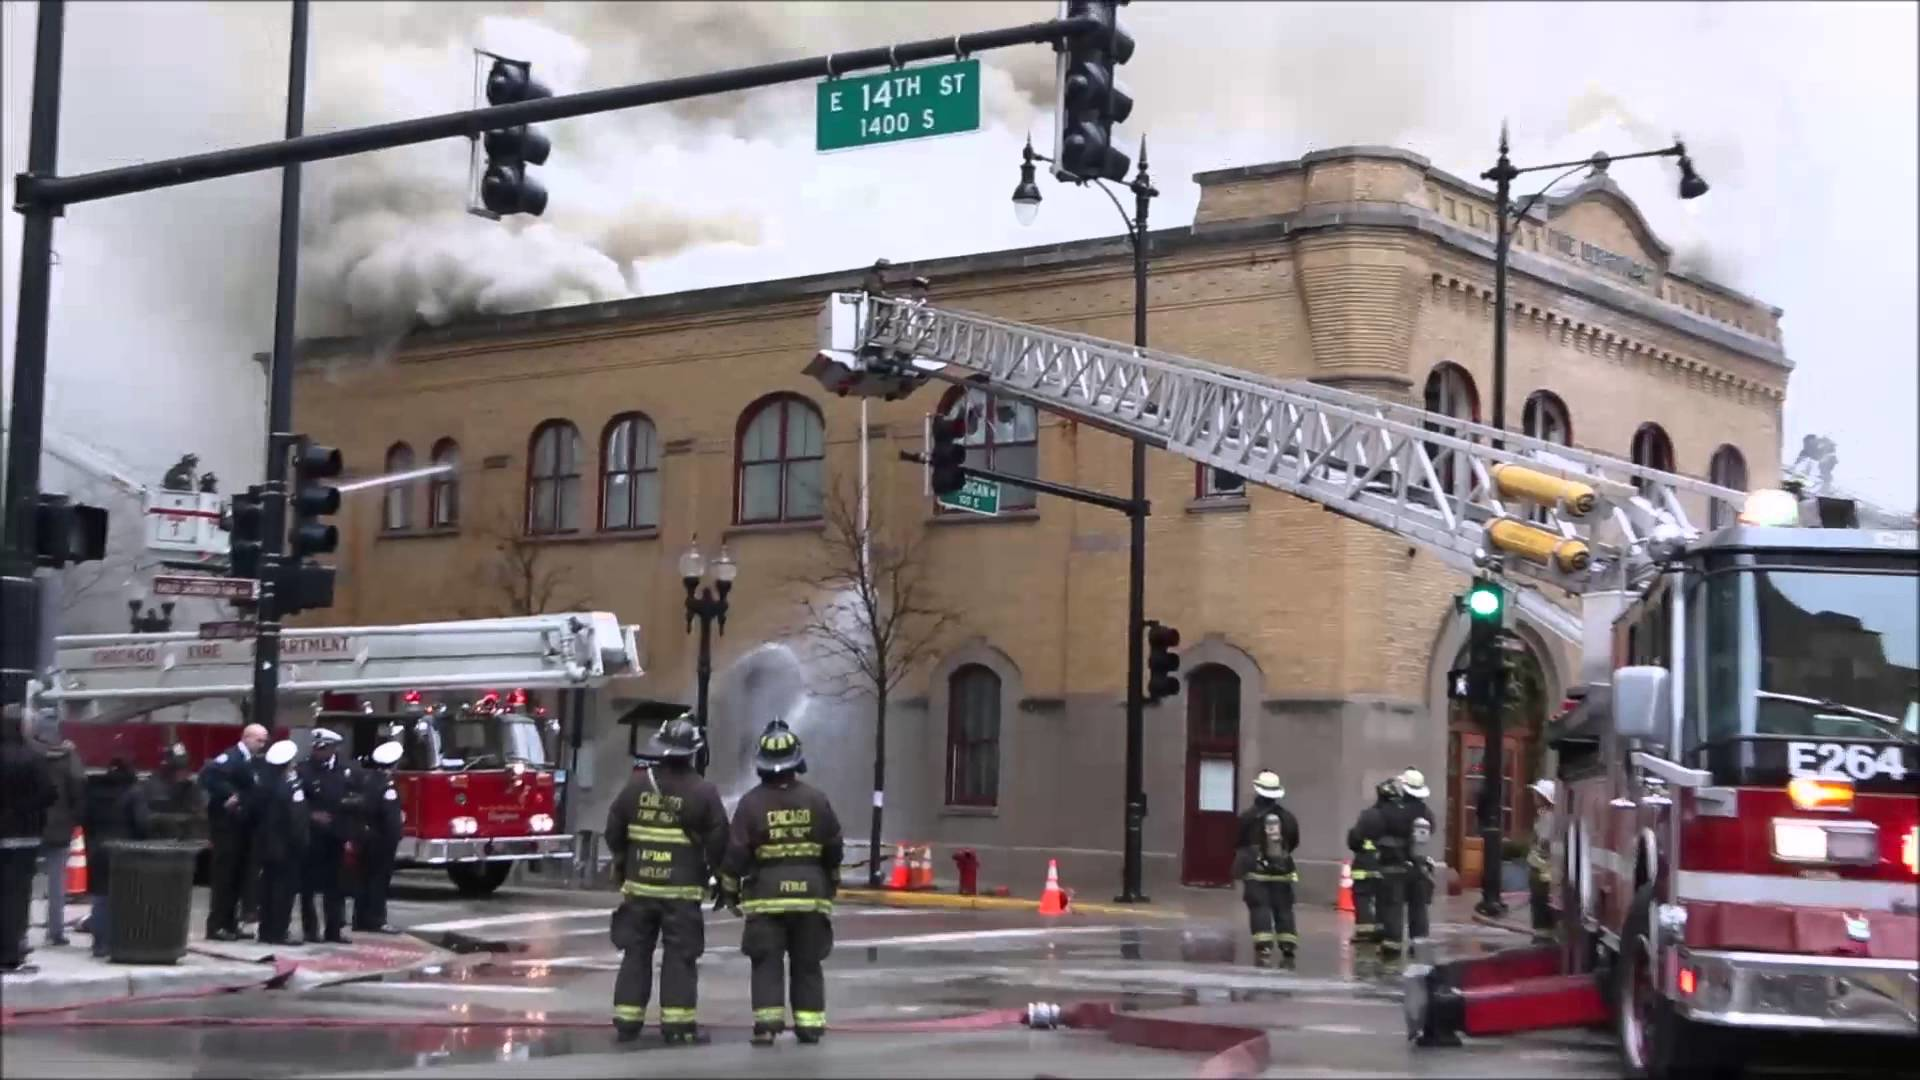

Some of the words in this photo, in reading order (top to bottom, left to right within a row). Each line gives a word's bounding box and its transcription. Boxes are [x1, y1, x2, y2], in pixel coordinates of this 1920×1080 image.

[830, 92, 843, 112] E
[862, 76, 921, 111] 14TH
[939, 73, 966, 96] ST
[860, 112, 909, 137] 1400
[922, 109, 935, 129] S
[1787, 741, 1908, 781] E264
[767, 809, 811, 827] CHICAGO
